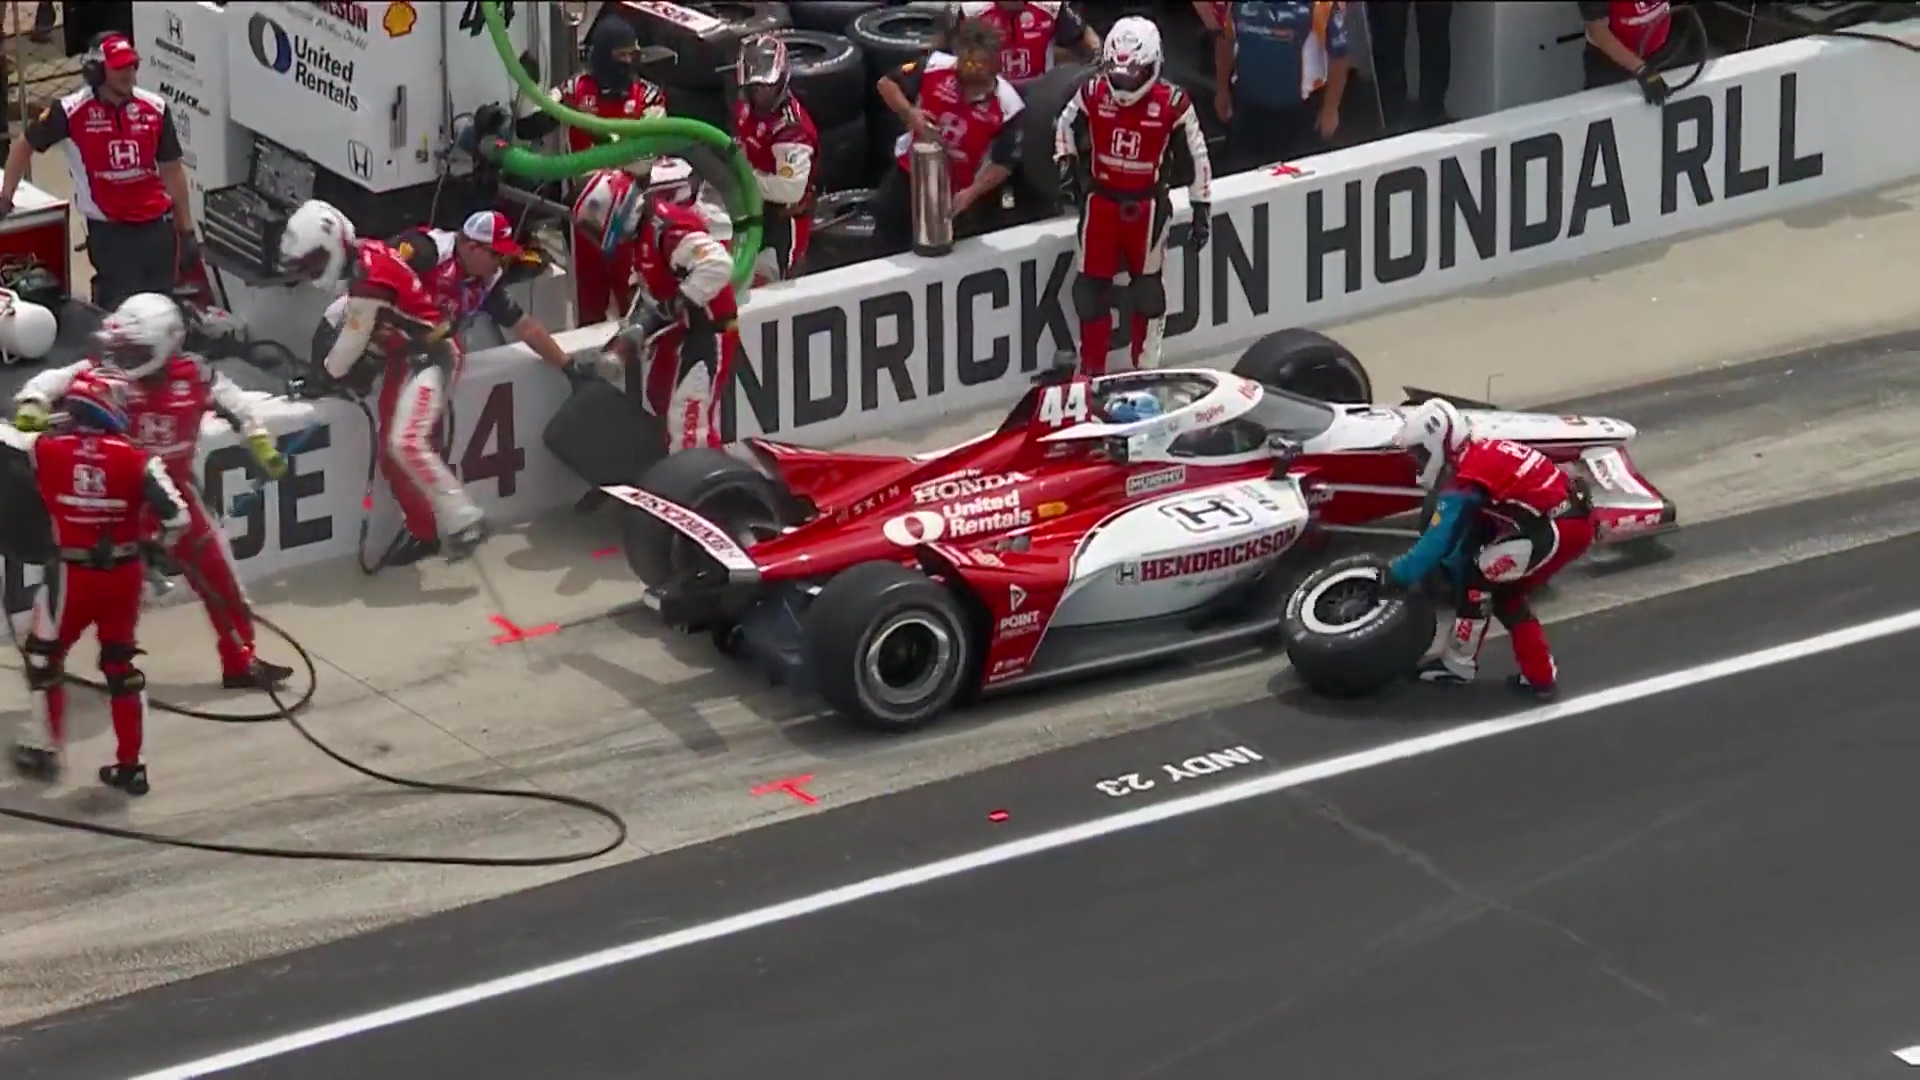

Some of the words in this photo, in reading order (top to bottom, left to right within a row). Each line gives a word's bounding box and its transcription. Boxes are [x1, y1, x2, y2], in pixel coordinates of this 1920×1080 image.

[294, 35, 354, 83] United
[173, 90, 200, 110] JACK
[295, 60, 359, 111] Rentals
[1306, 117, 1632, 304] HONDA
[1660, 72, 1824, 216] RLL
[1039, 382, 1088, 427] 44
[913, 471, 1032, 505] HONDA
[943, 489, 1019, 519] United
[949, 508, 1032, 538] Rentals
[1140, 525, 1297, 582] HENDRICKSON
[1000, 610, 1039, 630] POINT
[1162, 745, 1263, 782] INDY
[1096, 772, 1155, 797] 23
